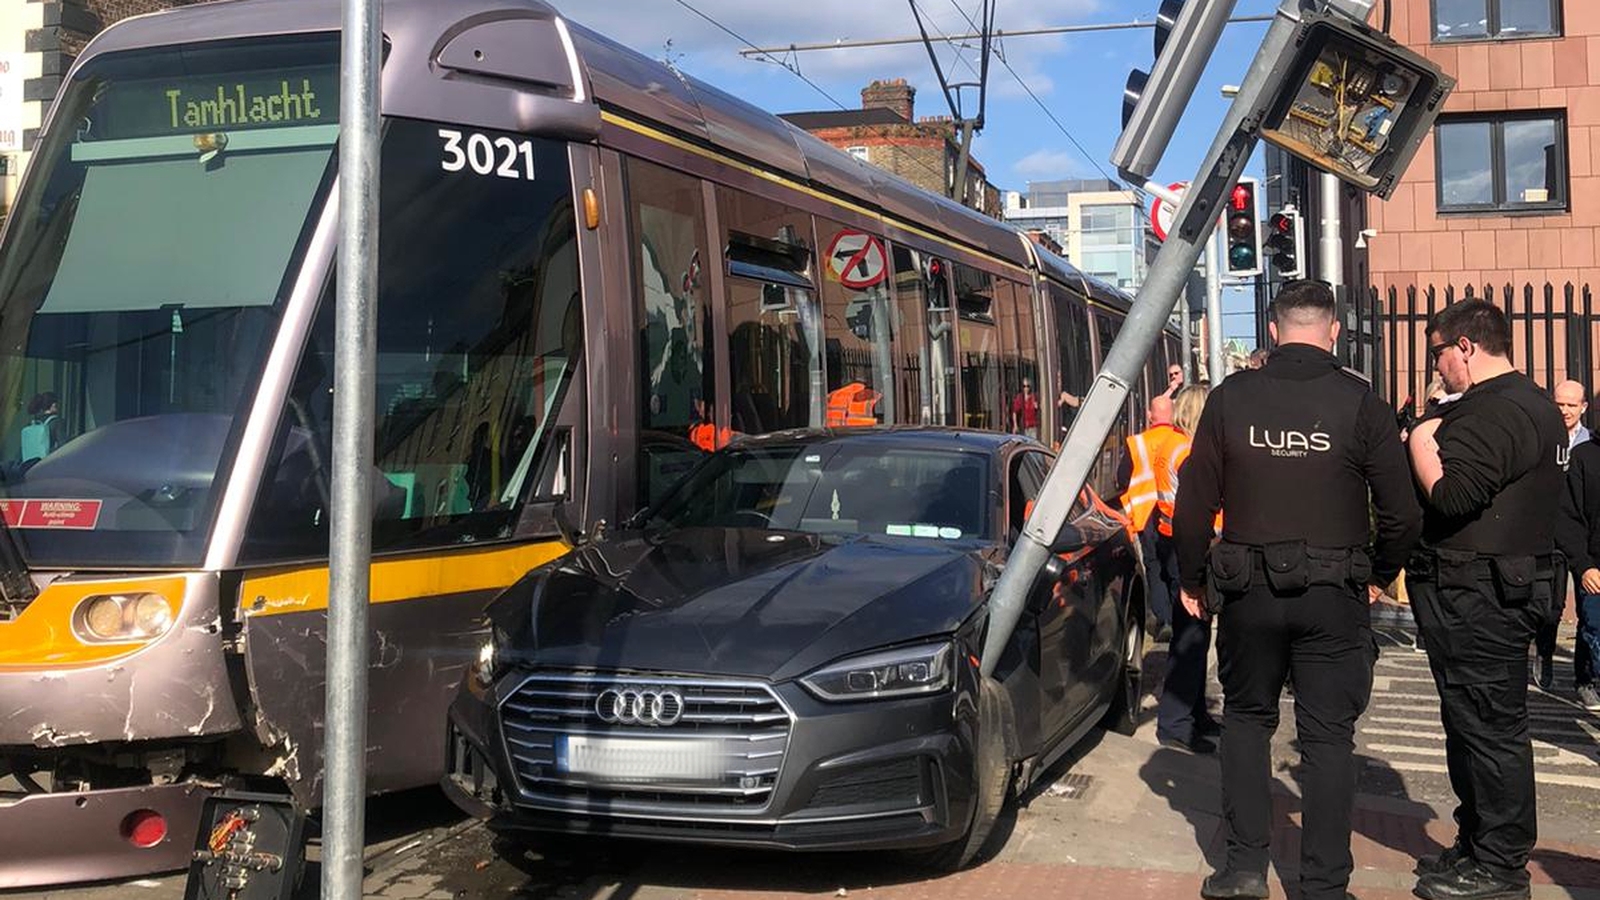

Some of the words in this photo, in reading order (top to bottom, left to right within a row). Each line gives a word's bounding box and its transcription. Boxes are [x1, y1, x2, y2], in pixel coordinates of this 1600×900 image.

[166, 79, 320, 128] Tamhlacht
[438, 129, 535, 180] 3021
[1249, 425, 1331, 451] LUAS
[1270, 449, 1309, 458] SECURITY
